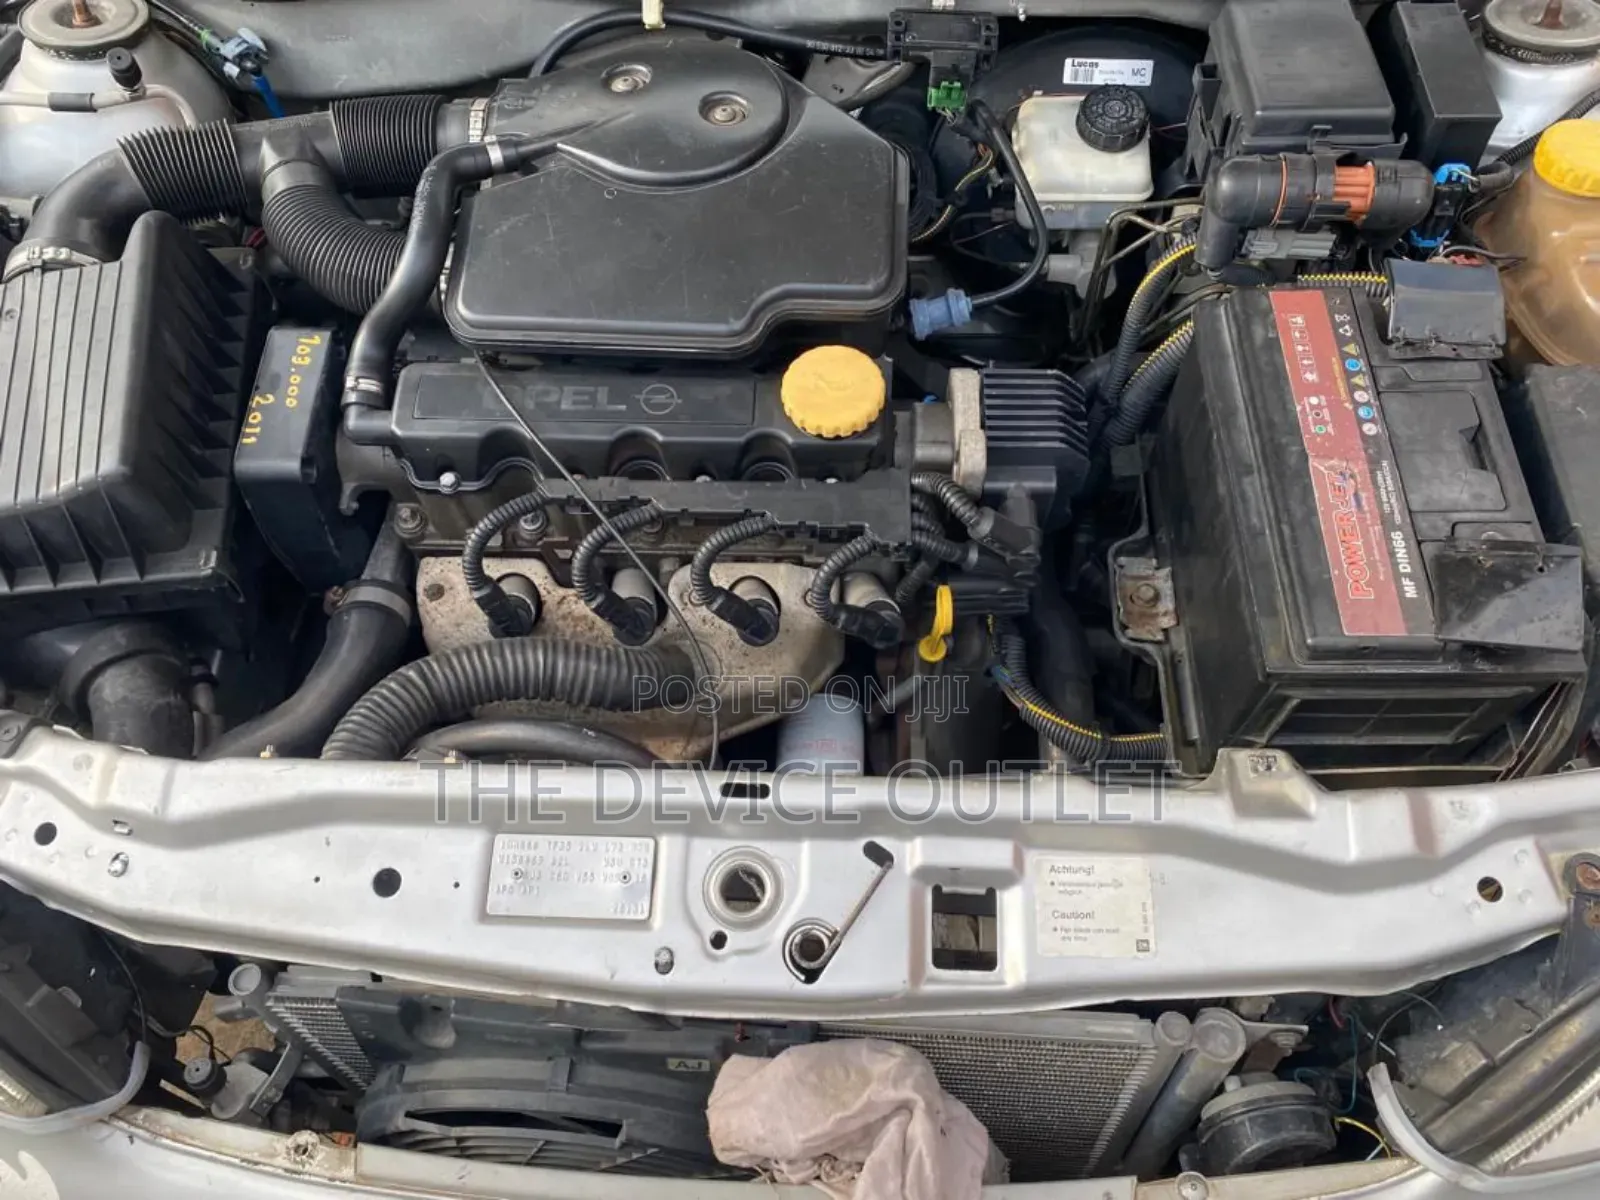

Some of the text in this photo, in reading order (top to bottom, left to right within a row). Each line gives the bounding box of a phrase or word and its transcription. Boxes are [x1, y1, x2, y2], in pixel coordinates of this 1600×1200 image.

[1071, 59, 1099, 68] Lucas
[1131, 68, 1146, 77] MC
[484, 384, 627, 412] OPEL
[241, 393, 275, 444] 2011
[1391, 531, 1418, 598] MF DIN66
[1049, 865, 1095, 876] Achtung!
[1052, 910, 1095, 920] Caution!
